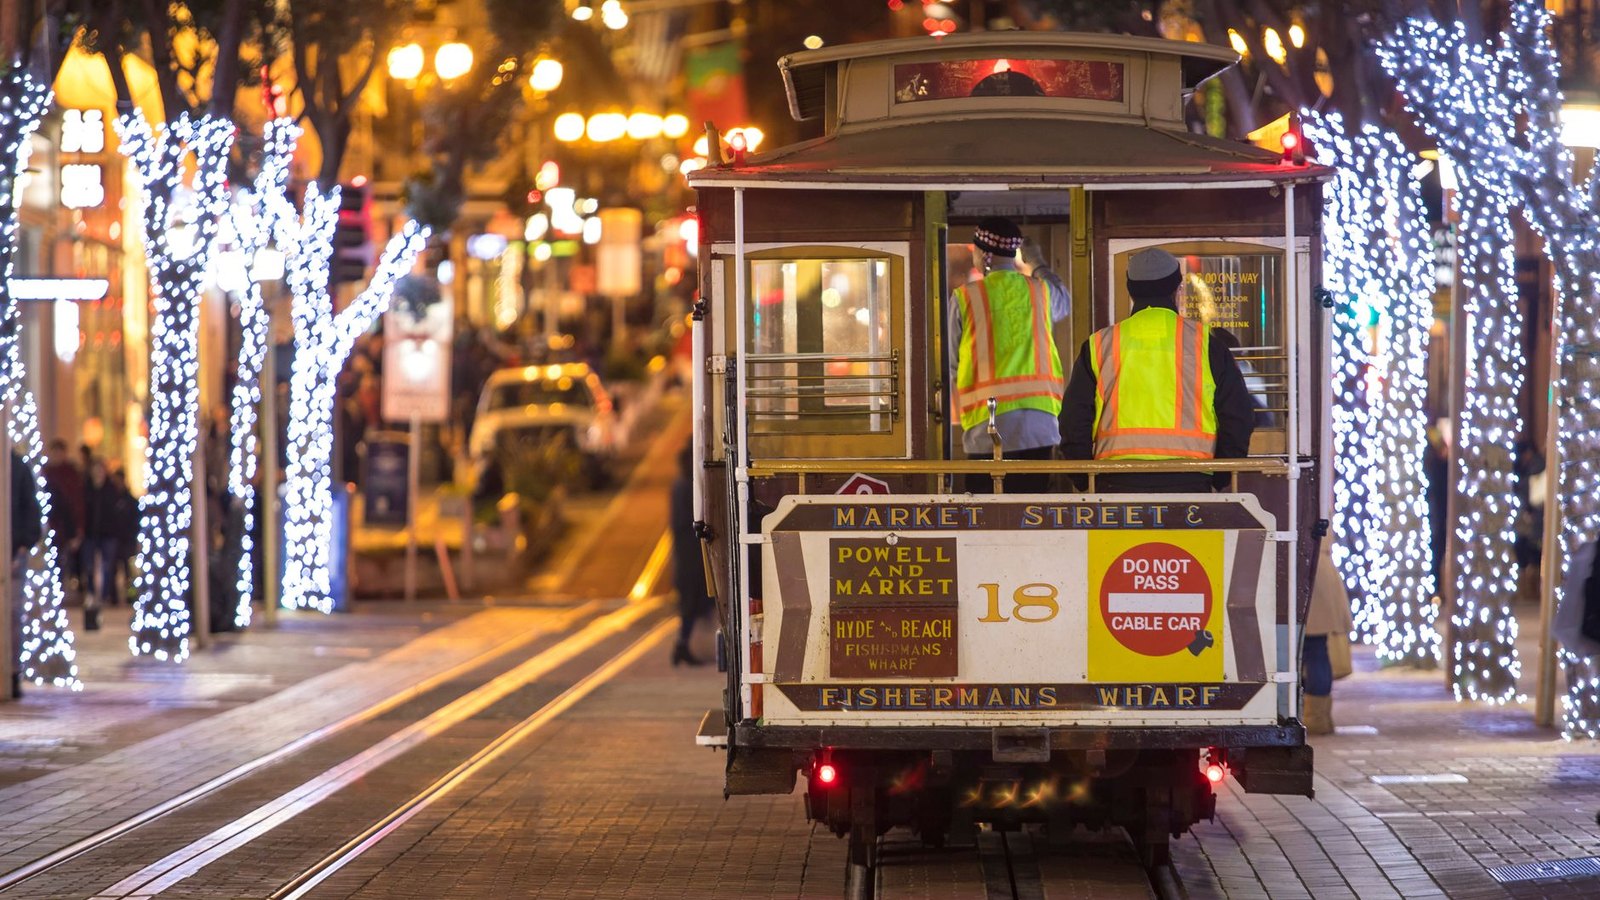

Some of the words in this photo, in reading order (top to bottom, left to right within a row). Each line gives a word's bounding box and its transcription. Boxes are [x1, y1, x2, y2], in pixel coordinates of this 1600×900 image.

[1218, 272, 1237, 284] ONE
[1239, 272, 1259, 284] WAY
[835, 506, 983, 528] MARKET
[1022, 505, 1168, 527] STREET
[1186, 505, 1203, 527] &
[838, 547, 951, 563] POWELL
[868, 565, 924, 577] AND
[1123, 559, 1149, 574] DO
[1153, 559, 1191, 574] NOT
[836, 580, 953, 595] MARKET
[1134, 575, 1180, 590] PASS
[977, 582, 1060, 623] 18
[836, 620, 875, 638] HYDE
[879, 621, 898, 638] AND
[901, 619, 952, 638] BEACH
[1111, 616, 1163, 631] CABLE
[1167, 616, 1201, 631] CAR
[868, 659, 918, 671] WHARF
[819, 687, 1057, 709] FISHERMANS
[1097, 686, 1220, 708] WHARF
